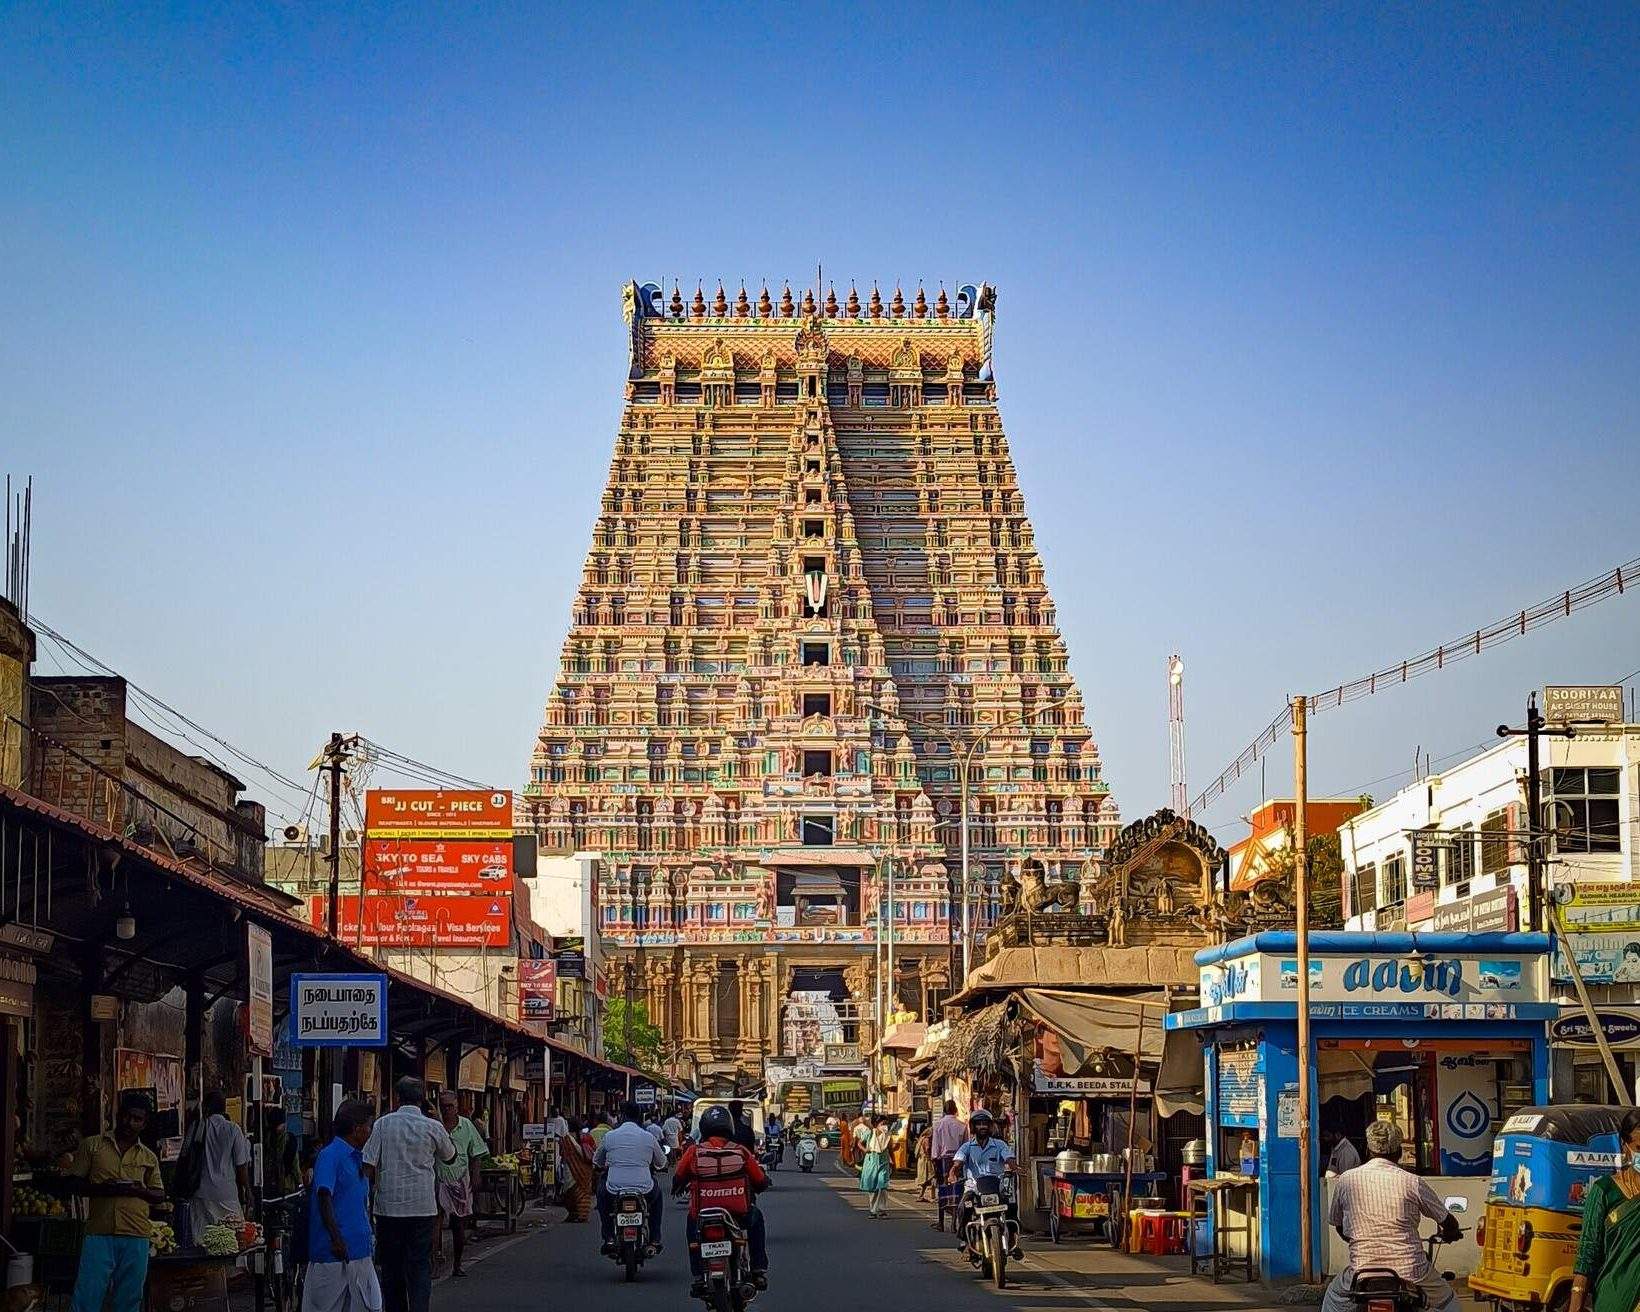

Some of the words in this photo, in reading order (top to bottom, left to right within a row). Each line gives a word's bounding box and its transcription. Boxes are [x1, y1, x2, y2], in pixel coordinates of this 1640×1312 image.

[1552, 689, 1617, 700] SOORIYAA
[1592, 702, 1618, 711] HOUSE
[381, 797, 395, 805] SRI
[395, 802, 407, 811] JJ
[411, 801, 435, 811] CUT
[451, 801, 483, 811] PIECE
[402, 853, 418, 863] TO
[421, 853, 445, 864] SEA
[461, 853, 481, 864] SKY
[482, 854, 508, 864] CABS
[447, 922, 464, 932] Visa
[303, 988, 376, 1006] நடைபாதை
[1337, 1004, 1360, 1016] ICE
[1363, 1004, 1419, 1016] CREAMS
[300, 1010, 378, 1034] நடப்பதற்கே
[1560, 1025, 1573, 1034] Sri
[1607, 1023, 1637, 1034] Sweets
[1077, 1081, 1107, 1089] BEEDA
[1109, 1081, 1136, 1089] STAL
[700, 1186, 745, 1197] zomato
